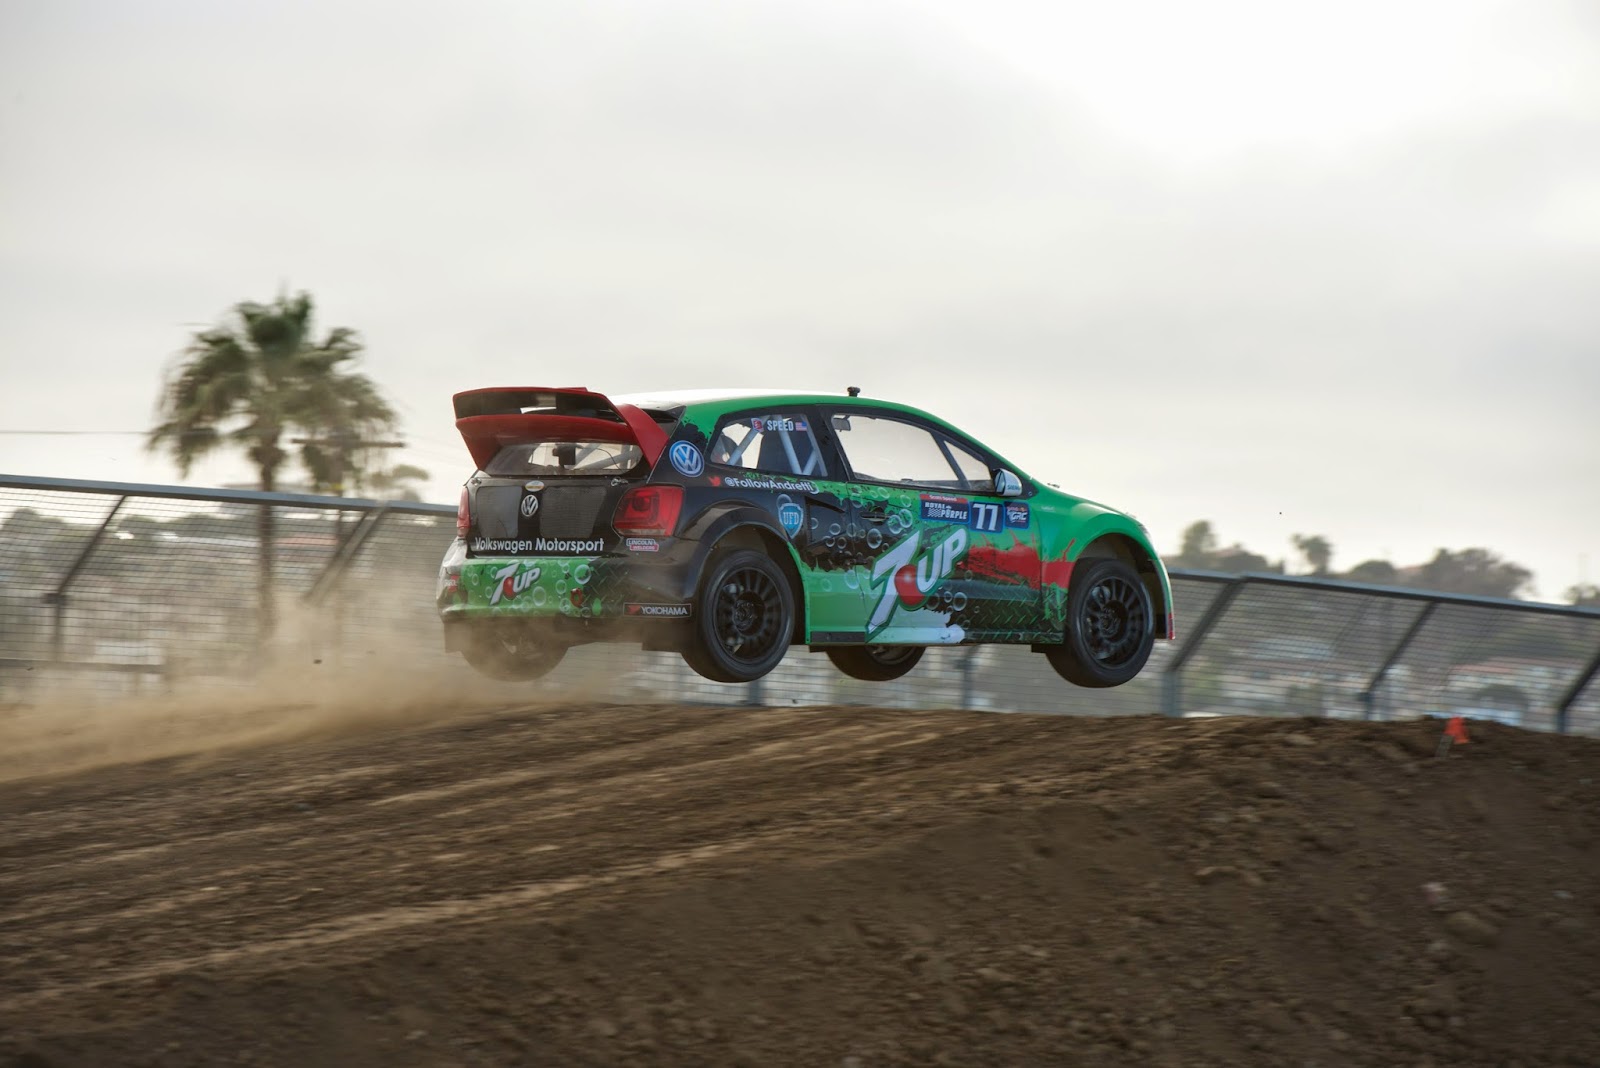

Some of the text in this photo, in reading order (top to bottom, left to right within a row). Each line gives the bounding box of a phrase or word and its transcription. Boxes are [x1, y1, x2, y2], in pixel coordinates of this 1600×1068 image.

[767, 420, 794, 431] SPEED
[725, 477, 814, 491] @FollowAndretti
[783, 512, 800, 525] UFD
[940, 509, 968, 520] PURPLE
[972, 503, 999, 531] 77
[475, 537, 605, 554] Volkswagen Motorsport
[641, 605, 688, 616] YOKOHAMA
